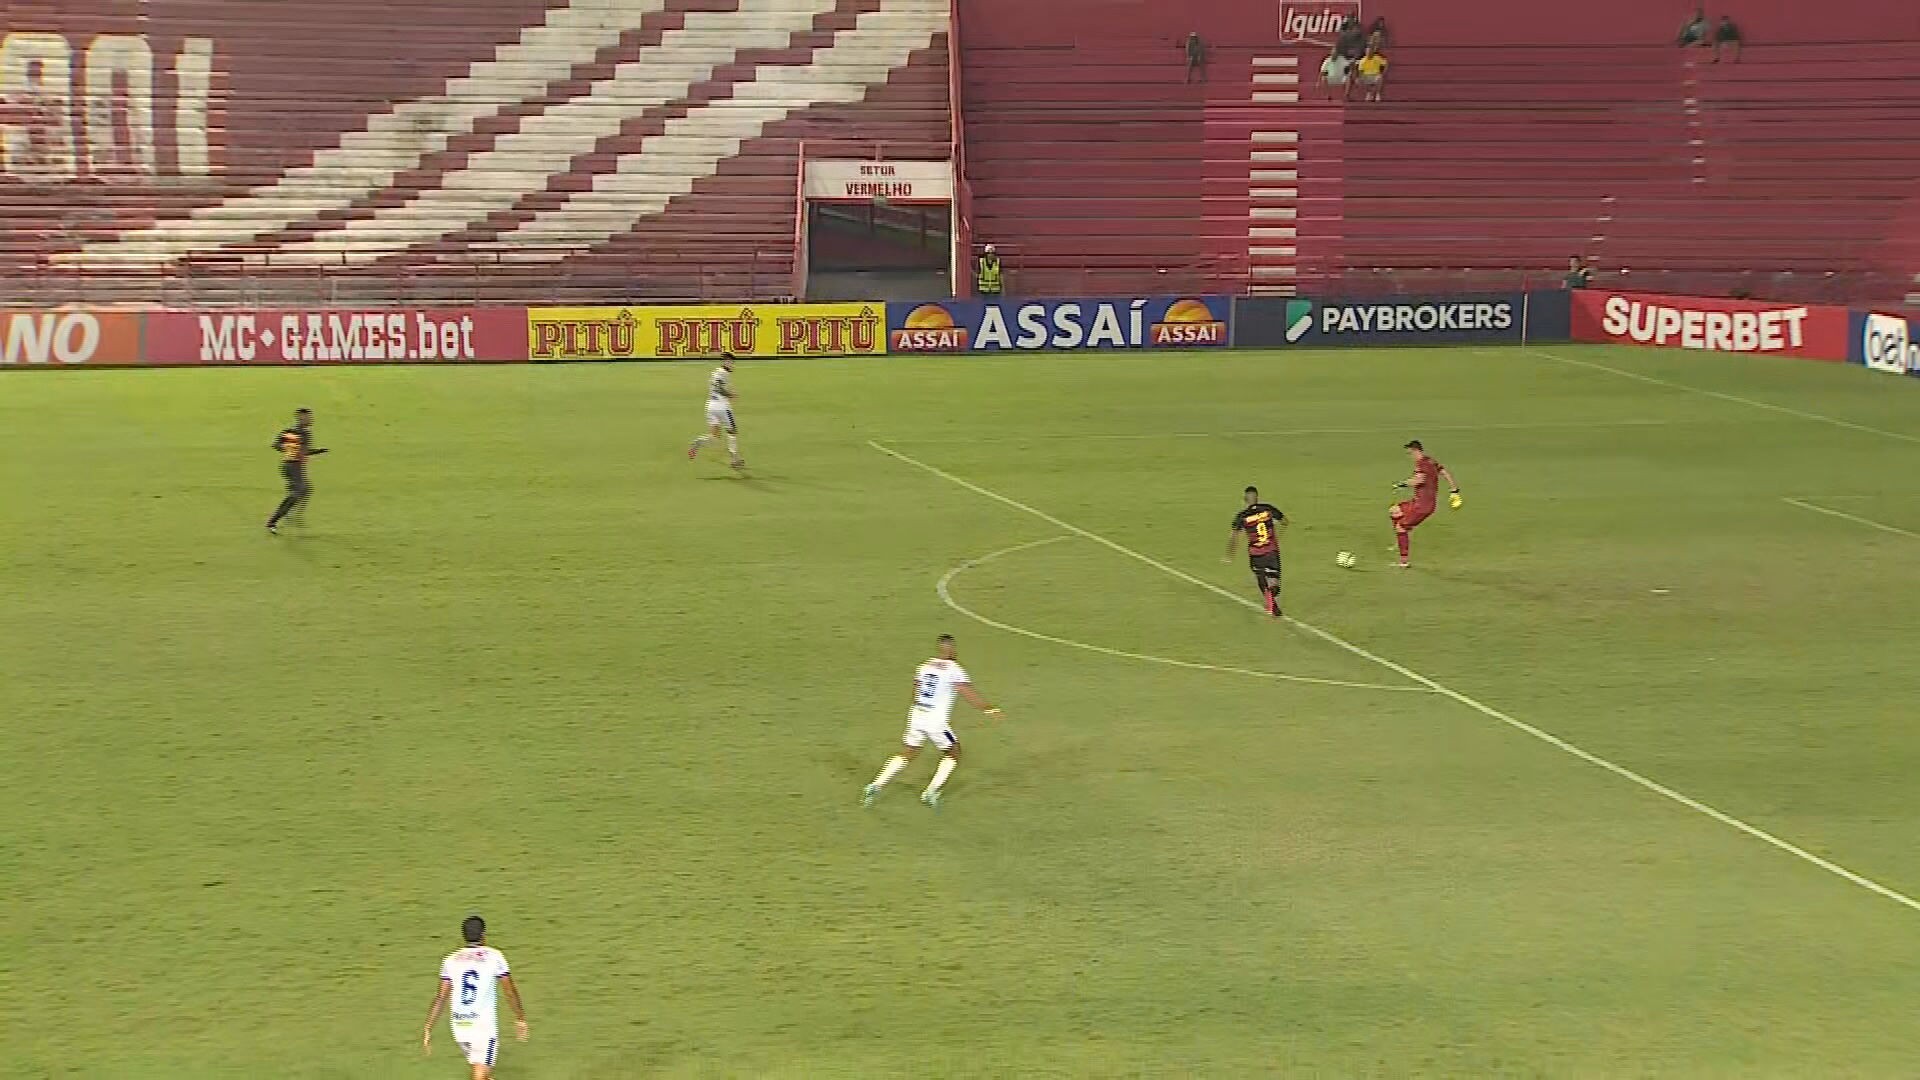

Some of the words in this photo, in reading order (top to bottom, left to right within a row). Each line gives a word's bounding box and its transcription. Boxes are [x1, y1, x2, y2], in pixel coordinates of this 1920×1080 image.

[1284, 7, 1347, 40] Iquin
[846, 183, 912, 196] VERMELHO
[974, 300, 1148, 349] ASSAÍ
[1322, 304, 1512, 332] PAYBROKERS
[1603, 296, 1807, 350] SUPERBET
[0, 313, 99, 363] NO
[200, 315, 256, 361] MC
[281, 312, 475, 360] GAMES.bet
[1257, 522, 1268, 544] 9
[461, 969, 480, 1005] 6
